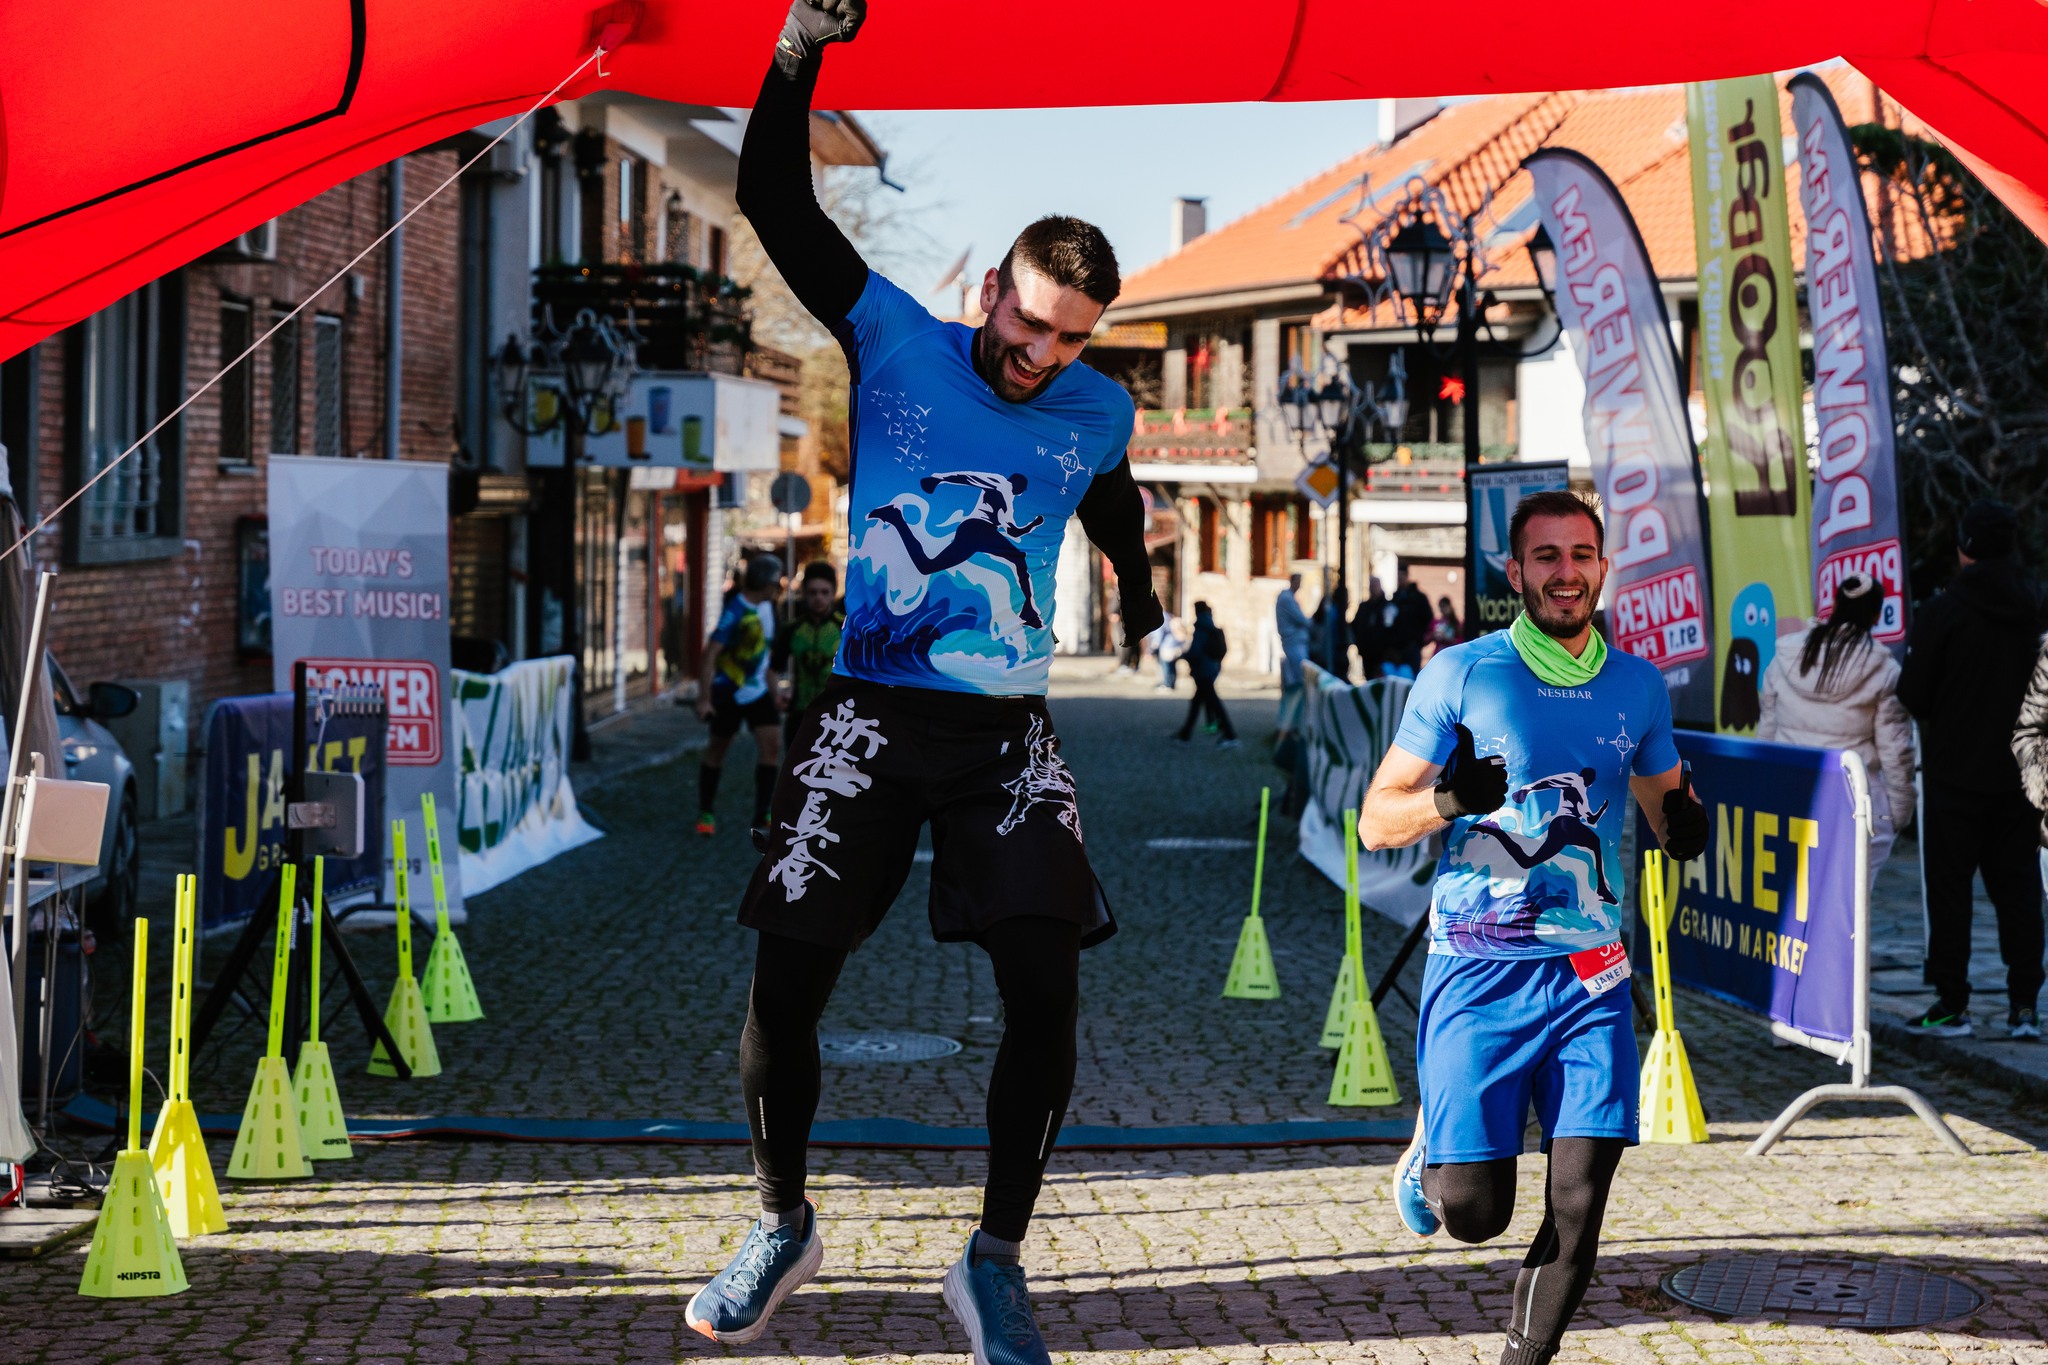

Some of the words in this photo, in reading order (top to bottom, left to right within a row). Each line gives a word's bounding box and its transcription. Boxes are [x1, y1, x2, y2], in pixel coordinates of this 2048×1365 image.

[1071, 432, 1079, 441] N
[1036, 446, 1048, 456] W
[1063, 457, 1077, 469] 21.1
[311, 547, 413, 578] TODAY'S
[282, 587, 346, 616] BEST
[353, 590, 441, 619] MUSIC!
[1537, 688, 1593, 700] NESEBAR
[1679, 905, 1733, 949] GRAND
[1739, 923, 1808, 976] MARKET
[1595, 966, 1624, 991] JANET
